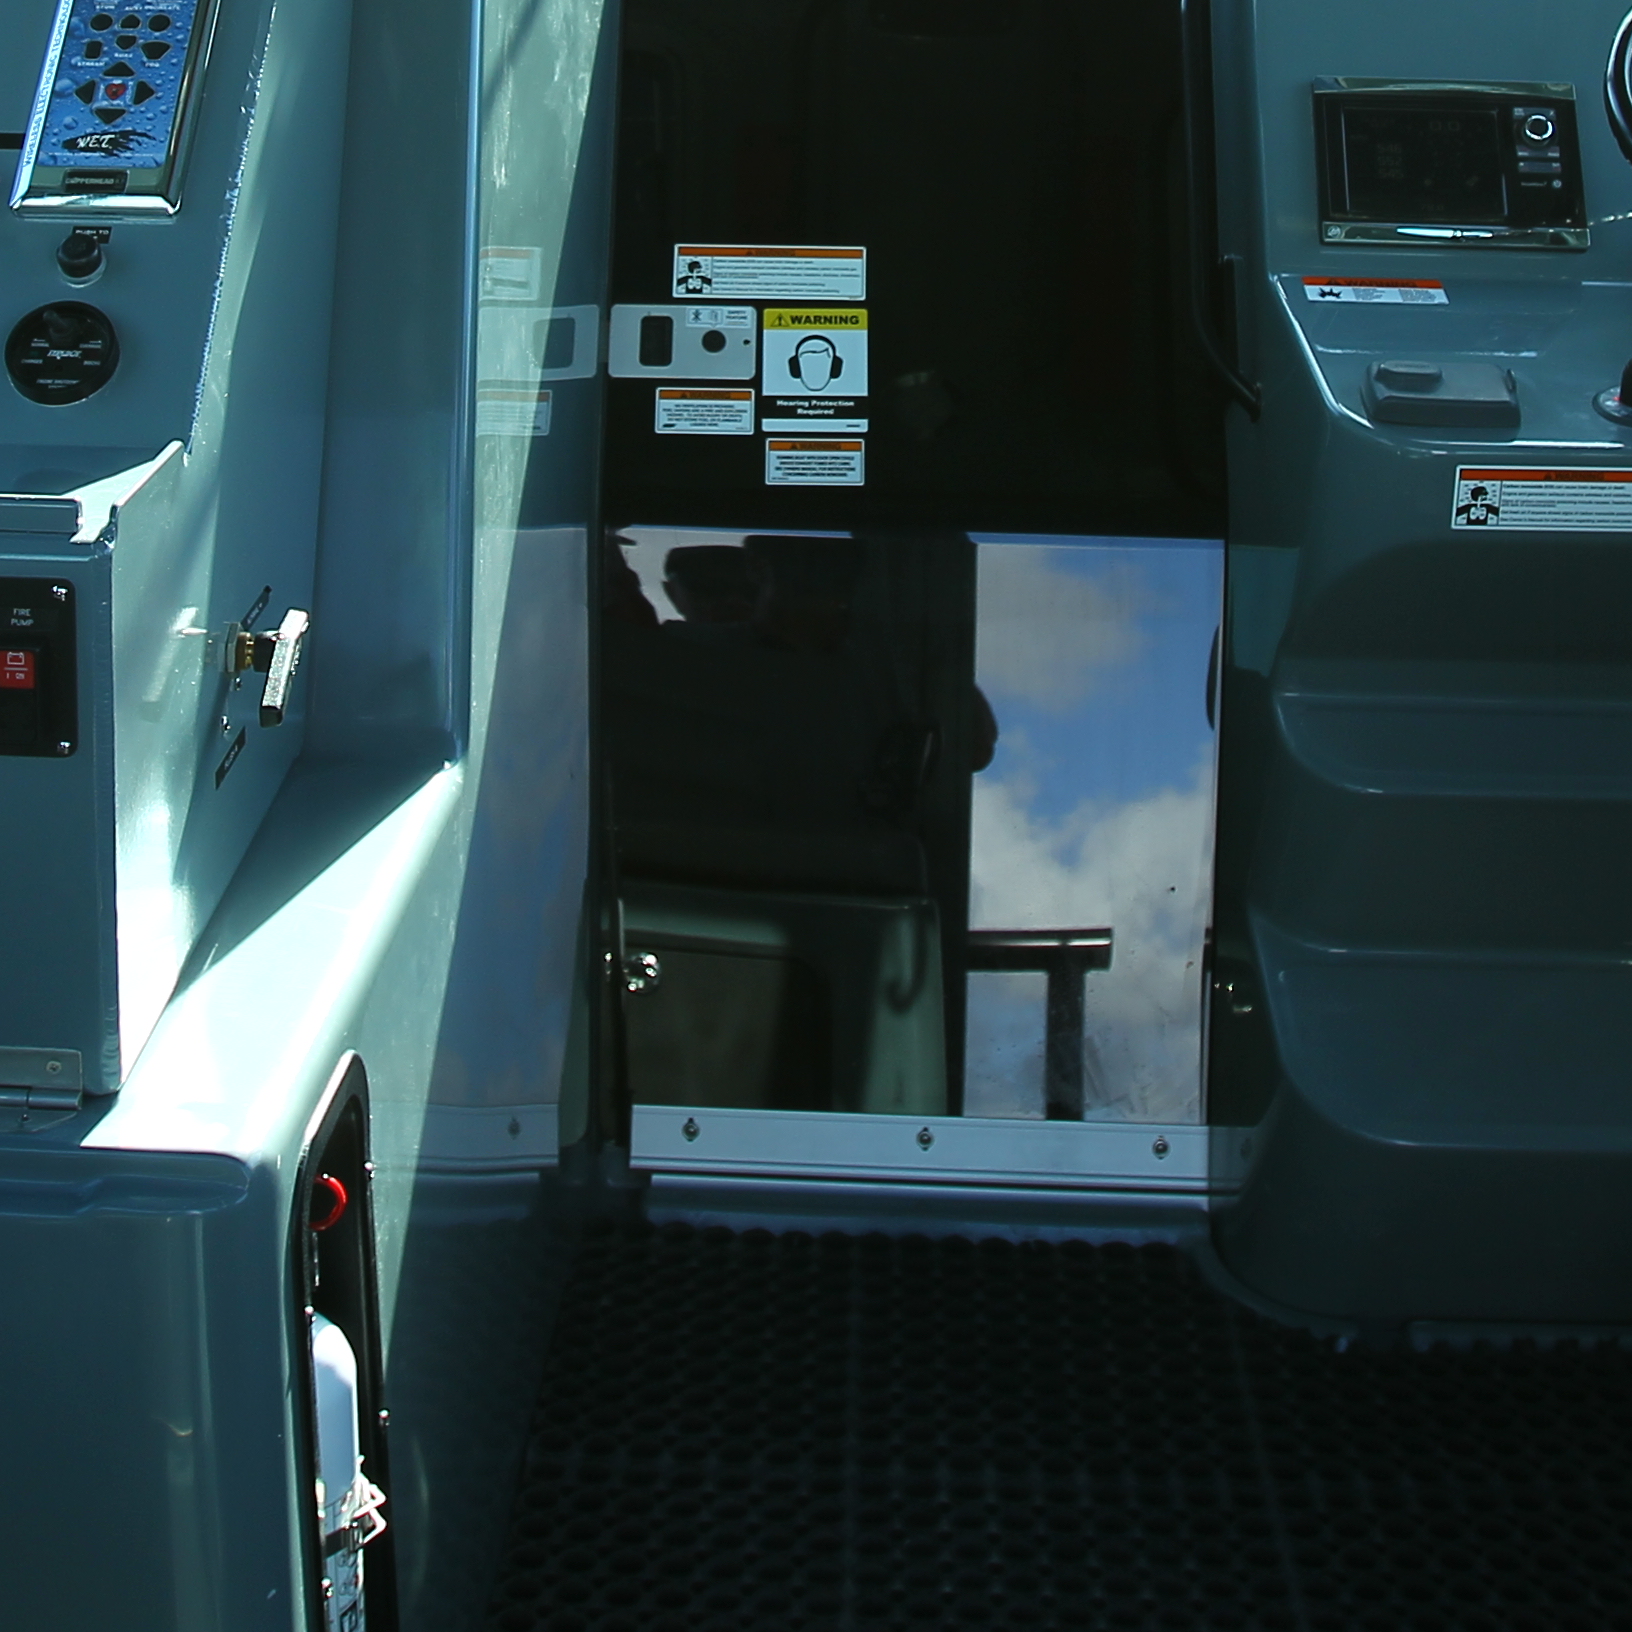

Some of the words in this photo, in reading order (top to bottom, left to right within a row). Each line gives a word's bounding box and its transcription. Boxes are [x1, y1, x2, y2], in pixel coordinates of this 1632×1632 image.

[790, 315, 860, 325] WARNING
[13, 608, 31, 616] FIRE
[10, 618, 34, 626] PUMP
